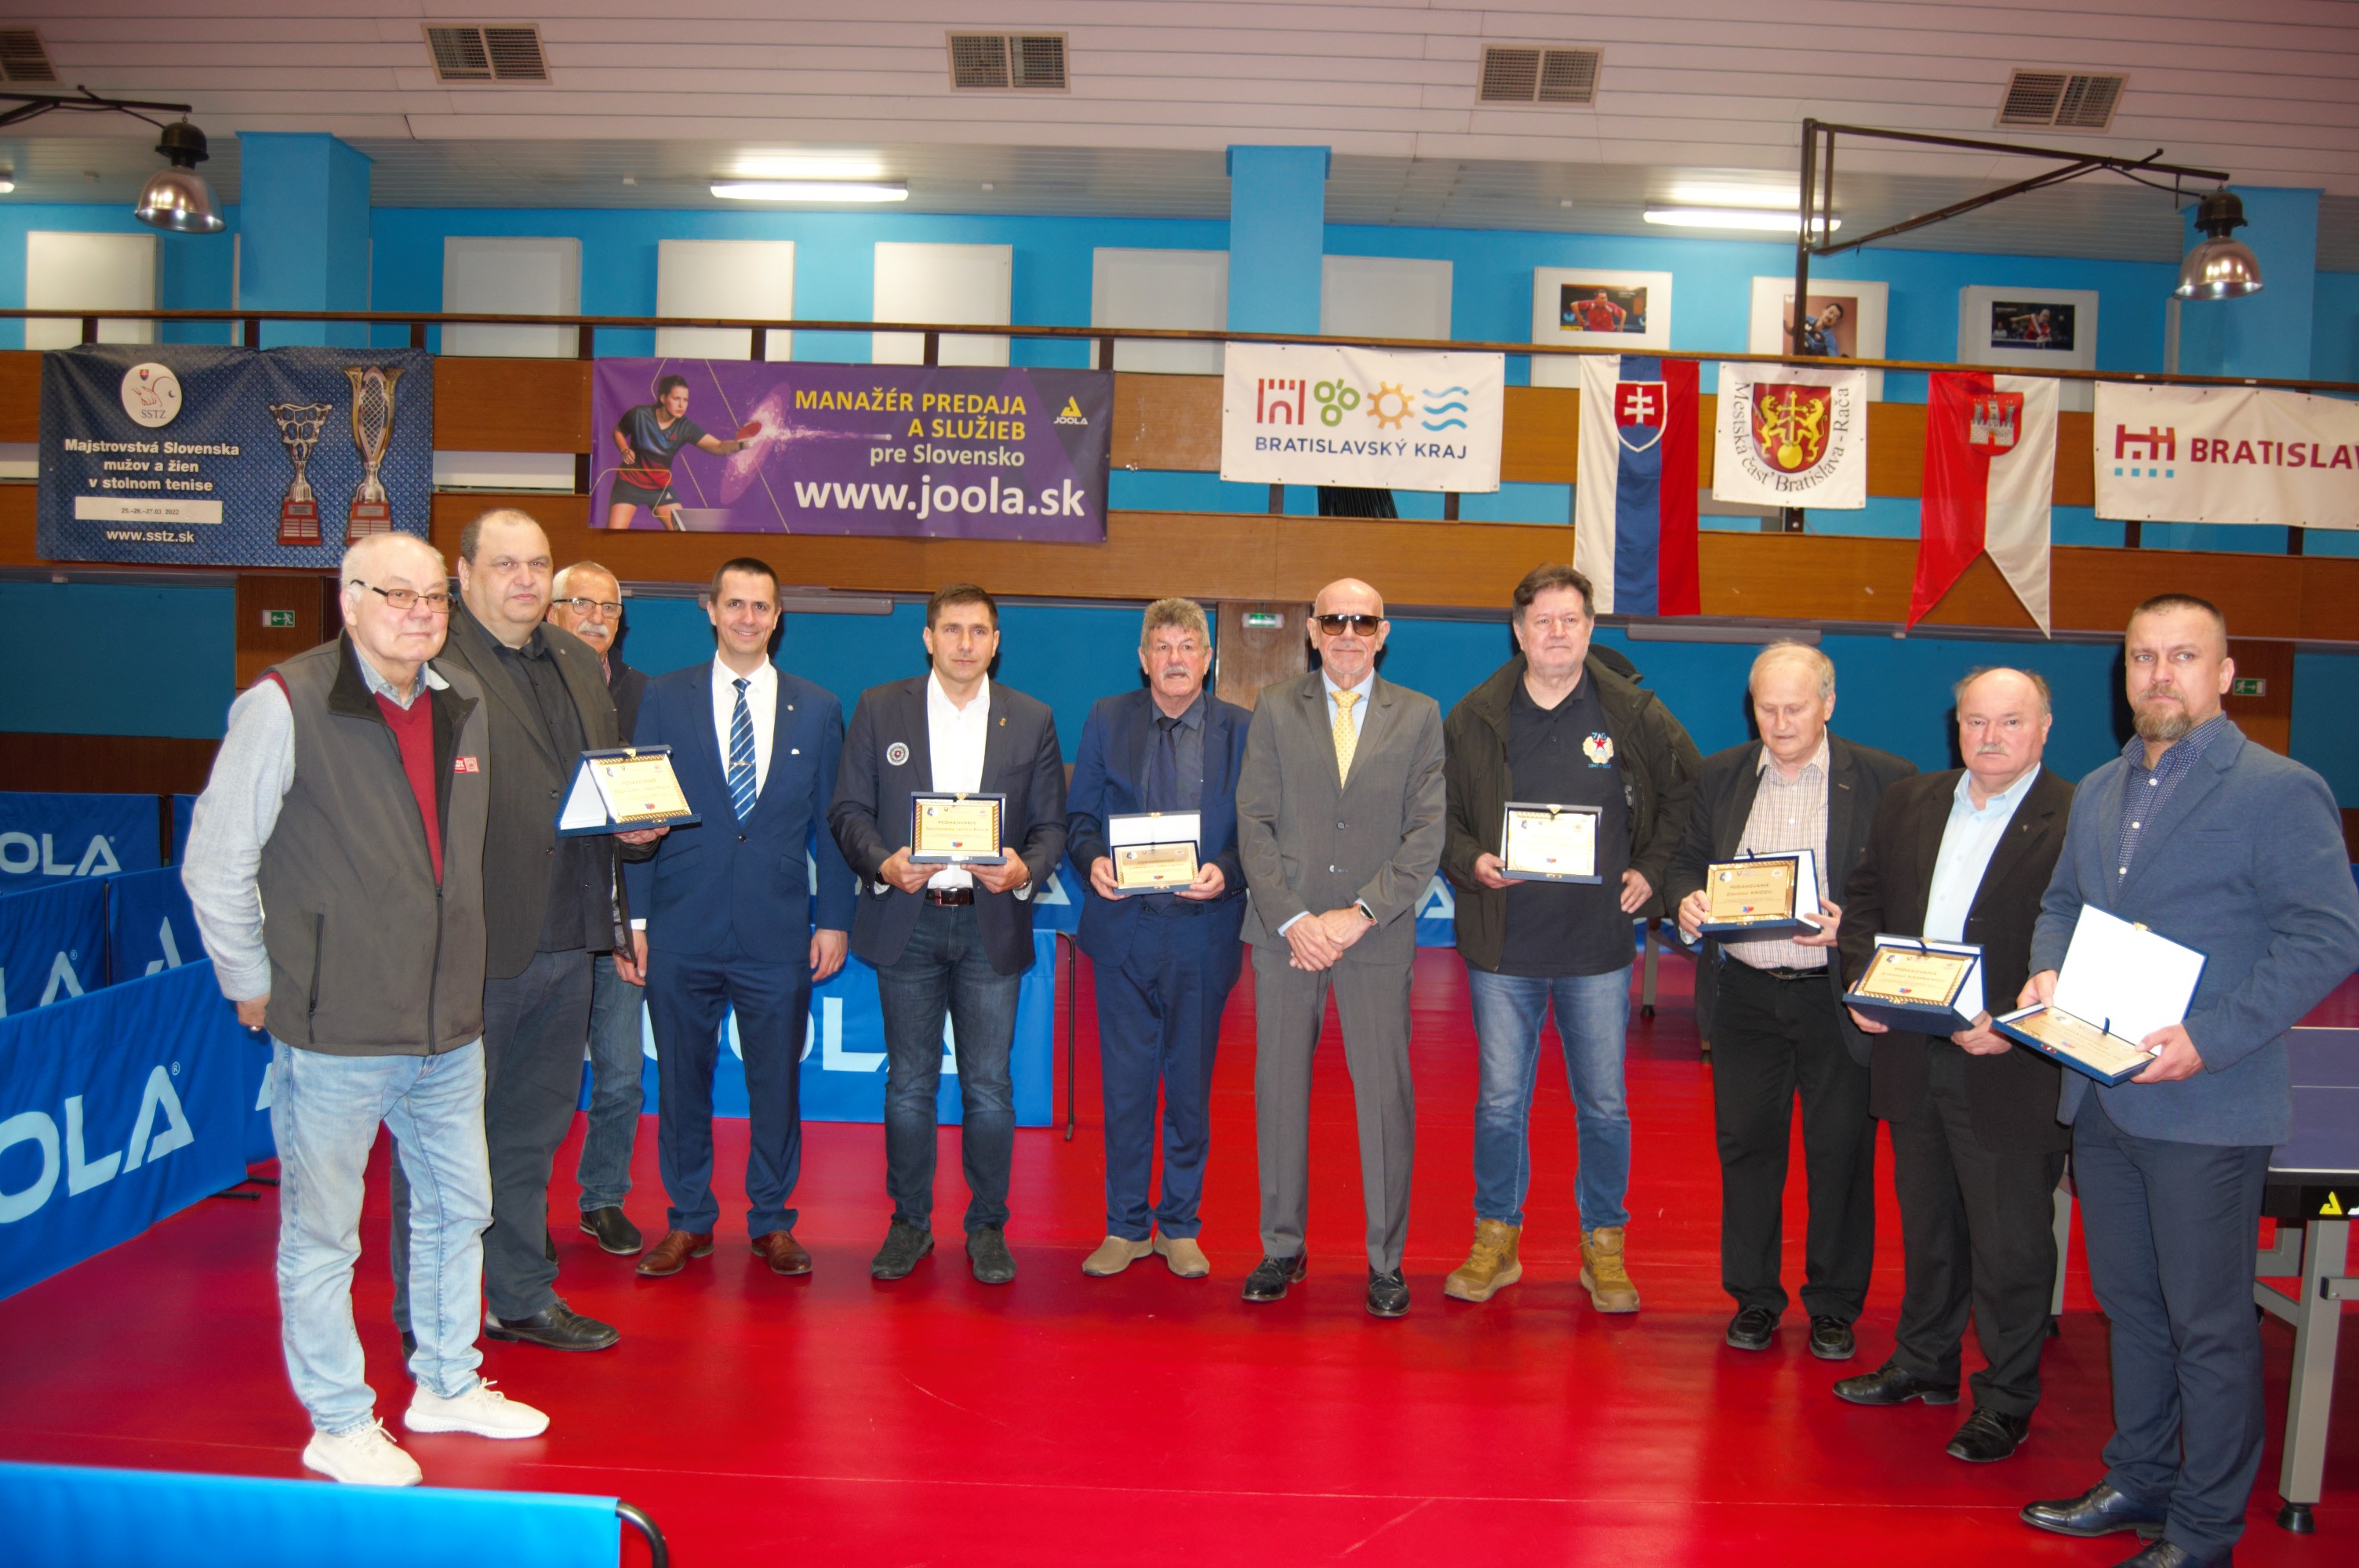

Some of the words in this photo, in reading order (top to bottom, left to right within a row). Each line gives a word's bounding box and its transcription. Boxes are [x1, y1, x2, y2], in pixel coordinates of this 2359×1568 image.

[795, 387, 914, 412] MANAŽÉR
[922, 394, 1027, 416] PREDAJA
[141, 409, 166, 419] SSTZ
[1053, 416, 1089, 425] JOOLA
[907, 419, 924, 437] A
[932, 416, 1026, 440] SLUŽIEB
[1733, 382, 1751, 455] Mestská
[1776, 446, 1845, 492] Bratislava
[1833, 387, 1850, 433] Rača
[64, 438, 159, 454] Majstrovstvá
[163, 441, 239, 456] Slovenska
[871, 446, 907, 466] pre
[913, 443, 1025, 466] Slovensko
[1256, 437, 1408, 457] BRATISLAVSKÝ
[1414, 443, 1467, 459] KRAJ
[2190, 437, 2359, 470] BRATISLA
[104, 459, 150, 471] mužov
[154, 463, 164, 471] a
[168, 459, 199, 473] žien
[89, 478, 98, 488] v
[103, 477, 161, 490] stolnom
[165, 478, 213, 492] tenise
[794, 474, 1085, 520] www.joola.sk
[107, 530, 195, 543] www.sstz.sk
